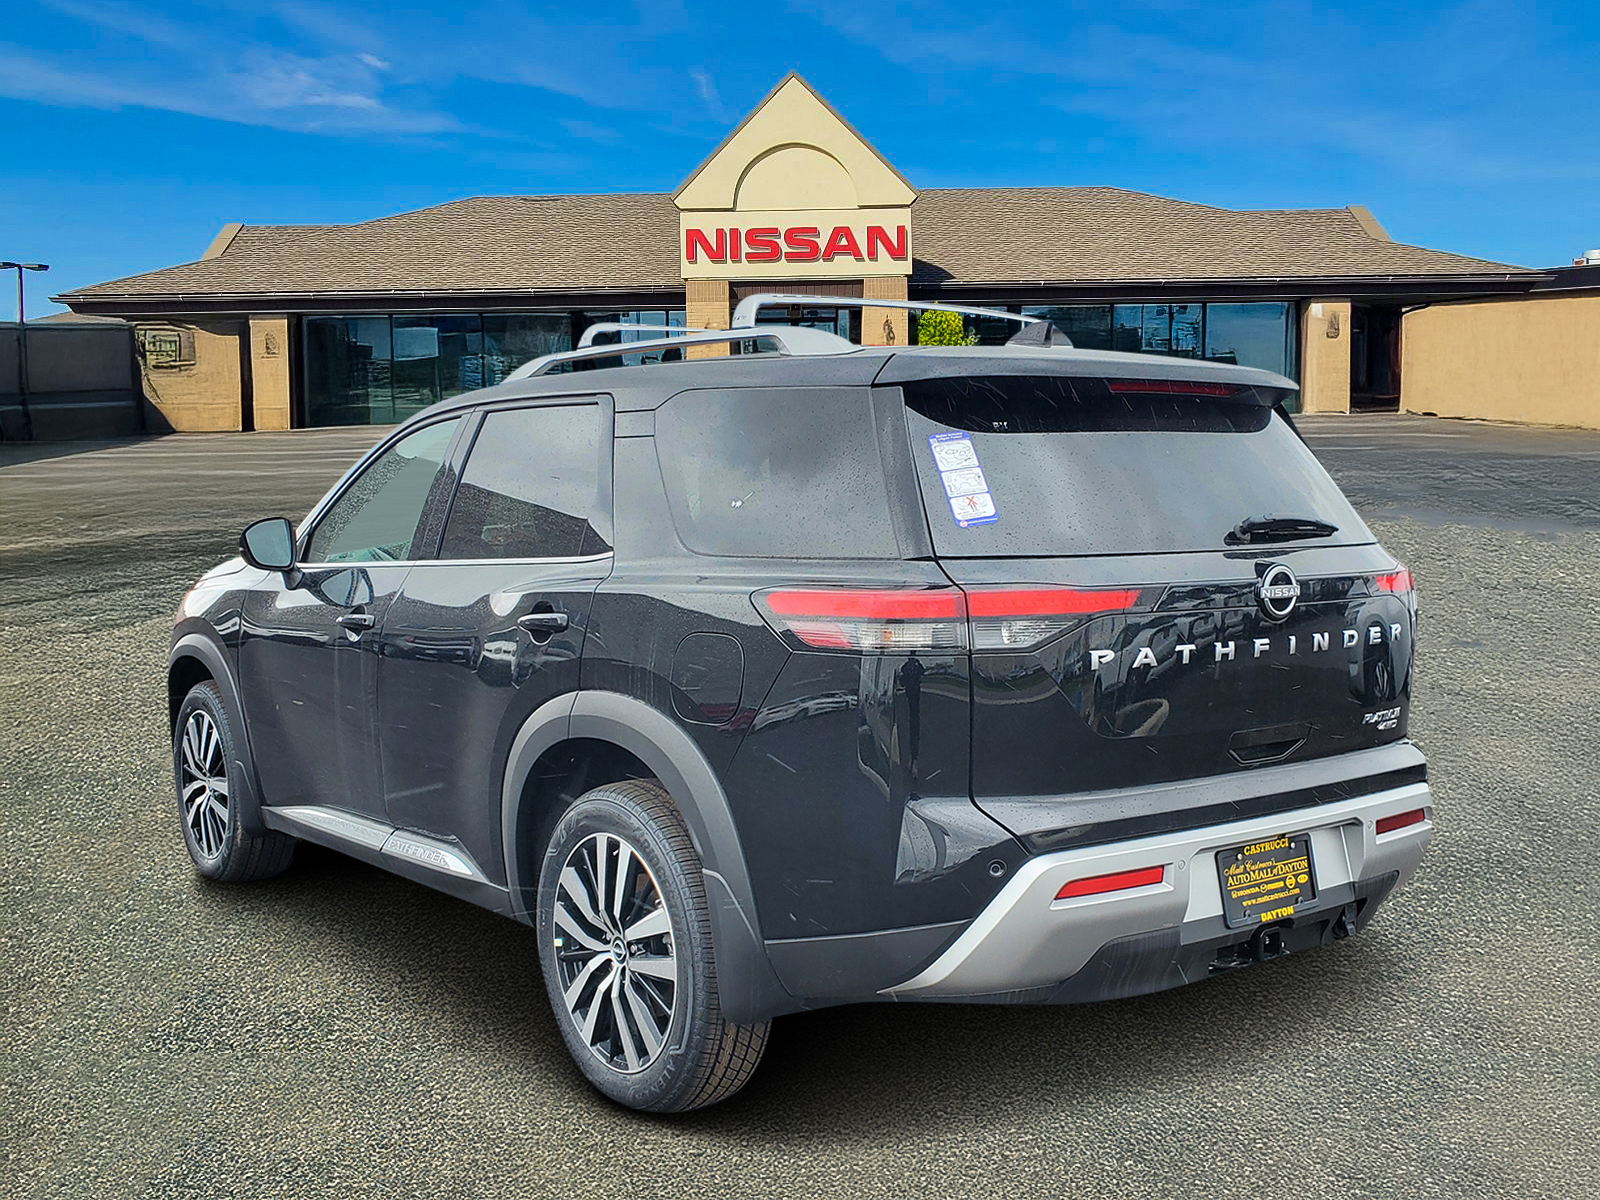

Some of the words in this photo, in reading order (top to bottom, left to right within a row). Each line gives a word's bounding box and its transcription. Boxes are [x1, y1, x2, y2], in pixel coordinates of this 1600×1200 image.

[685, 225, 908, 264] NISSAN
[1260, 587, 1300, 599] NISSAN
[1090, 623, 1403, 671] PATHFINDER
[1243, 838, 1289, 856] CASTRUCCI
[1260, 905, 1294, 922] DAYTON
